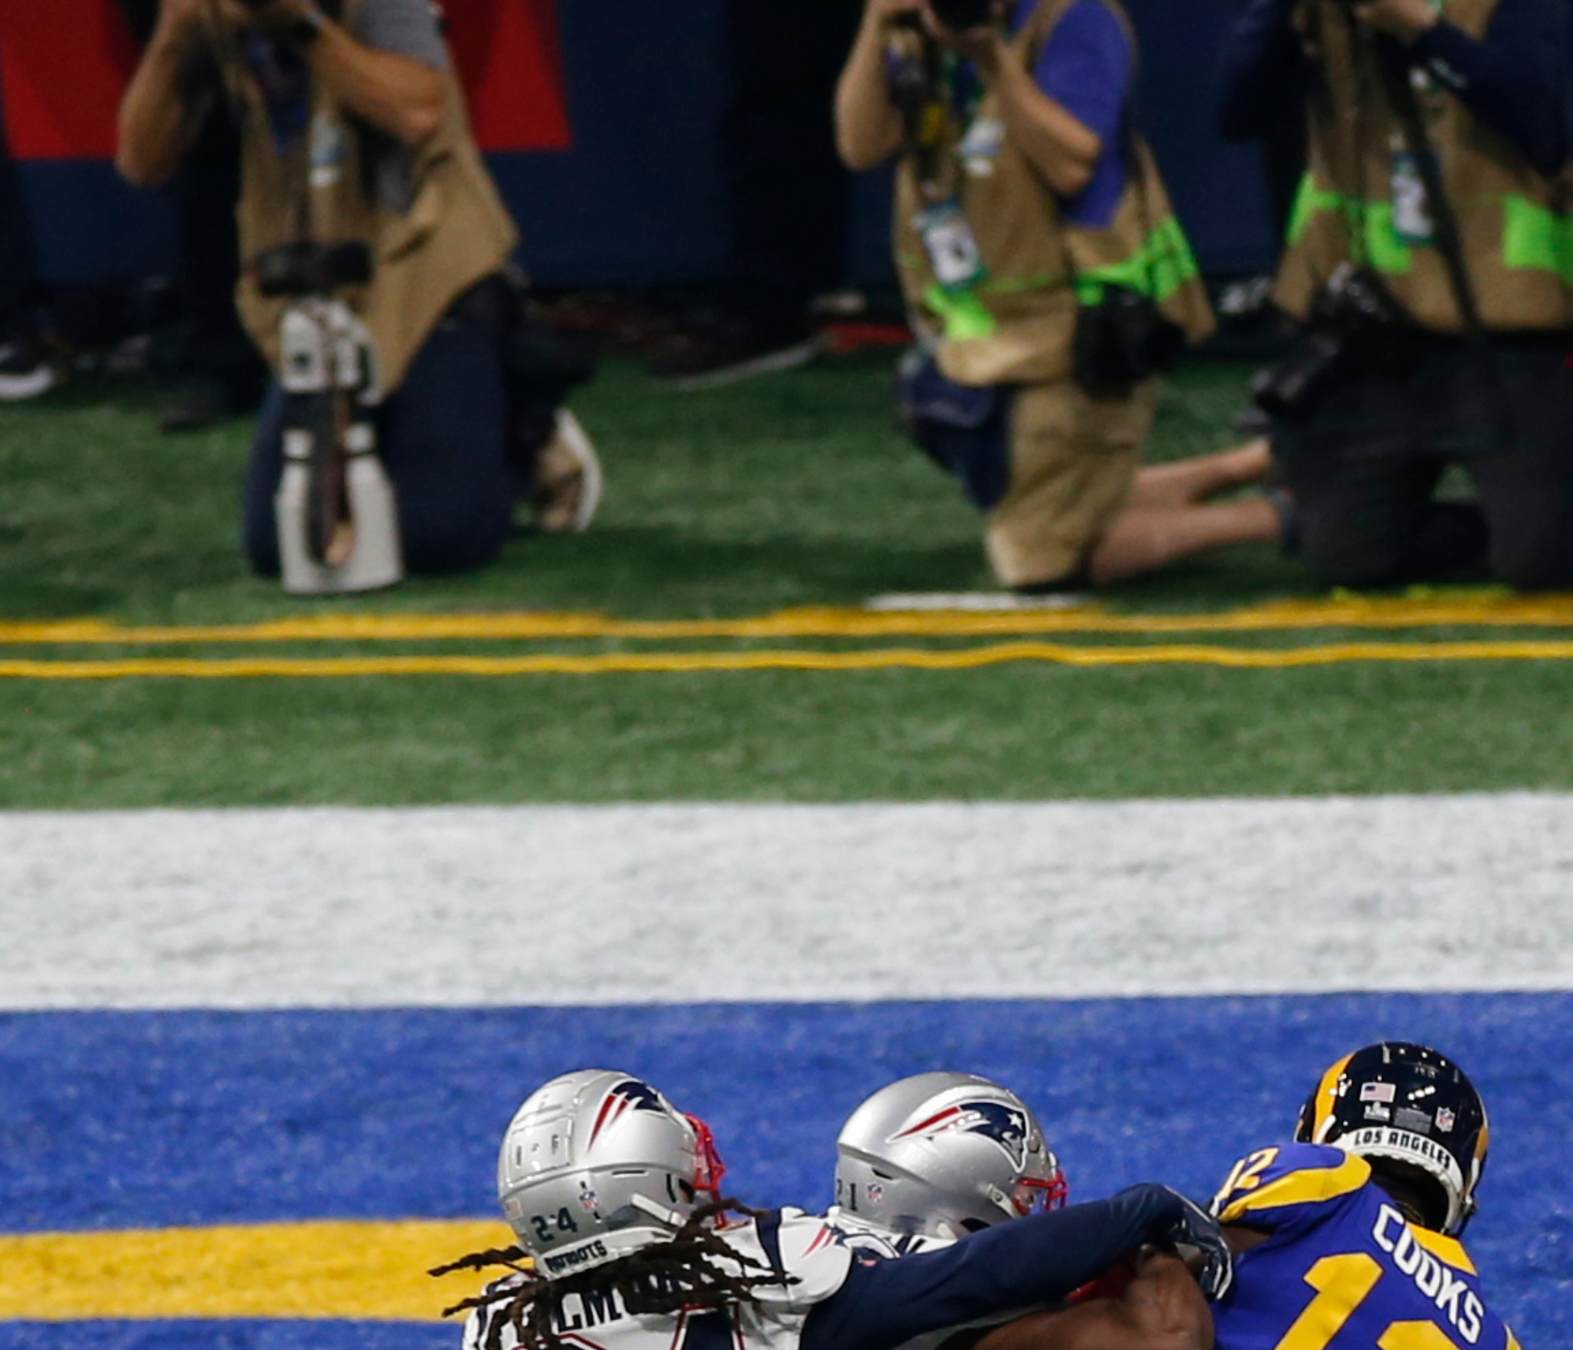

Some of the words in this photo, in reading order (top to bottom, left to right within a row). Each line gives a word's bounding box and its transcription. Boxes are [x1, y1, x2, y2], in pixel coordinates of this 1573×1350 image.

[1354, 1130, 1382, 1146] LOS
[1388, 1131, 1451, 1170] ANGELES
[530, 1206, 578, 1242] 24
[543, 1239, 608, 1273] PATRIOTS
[1372, 1203, 1485, 1344] COOKS
